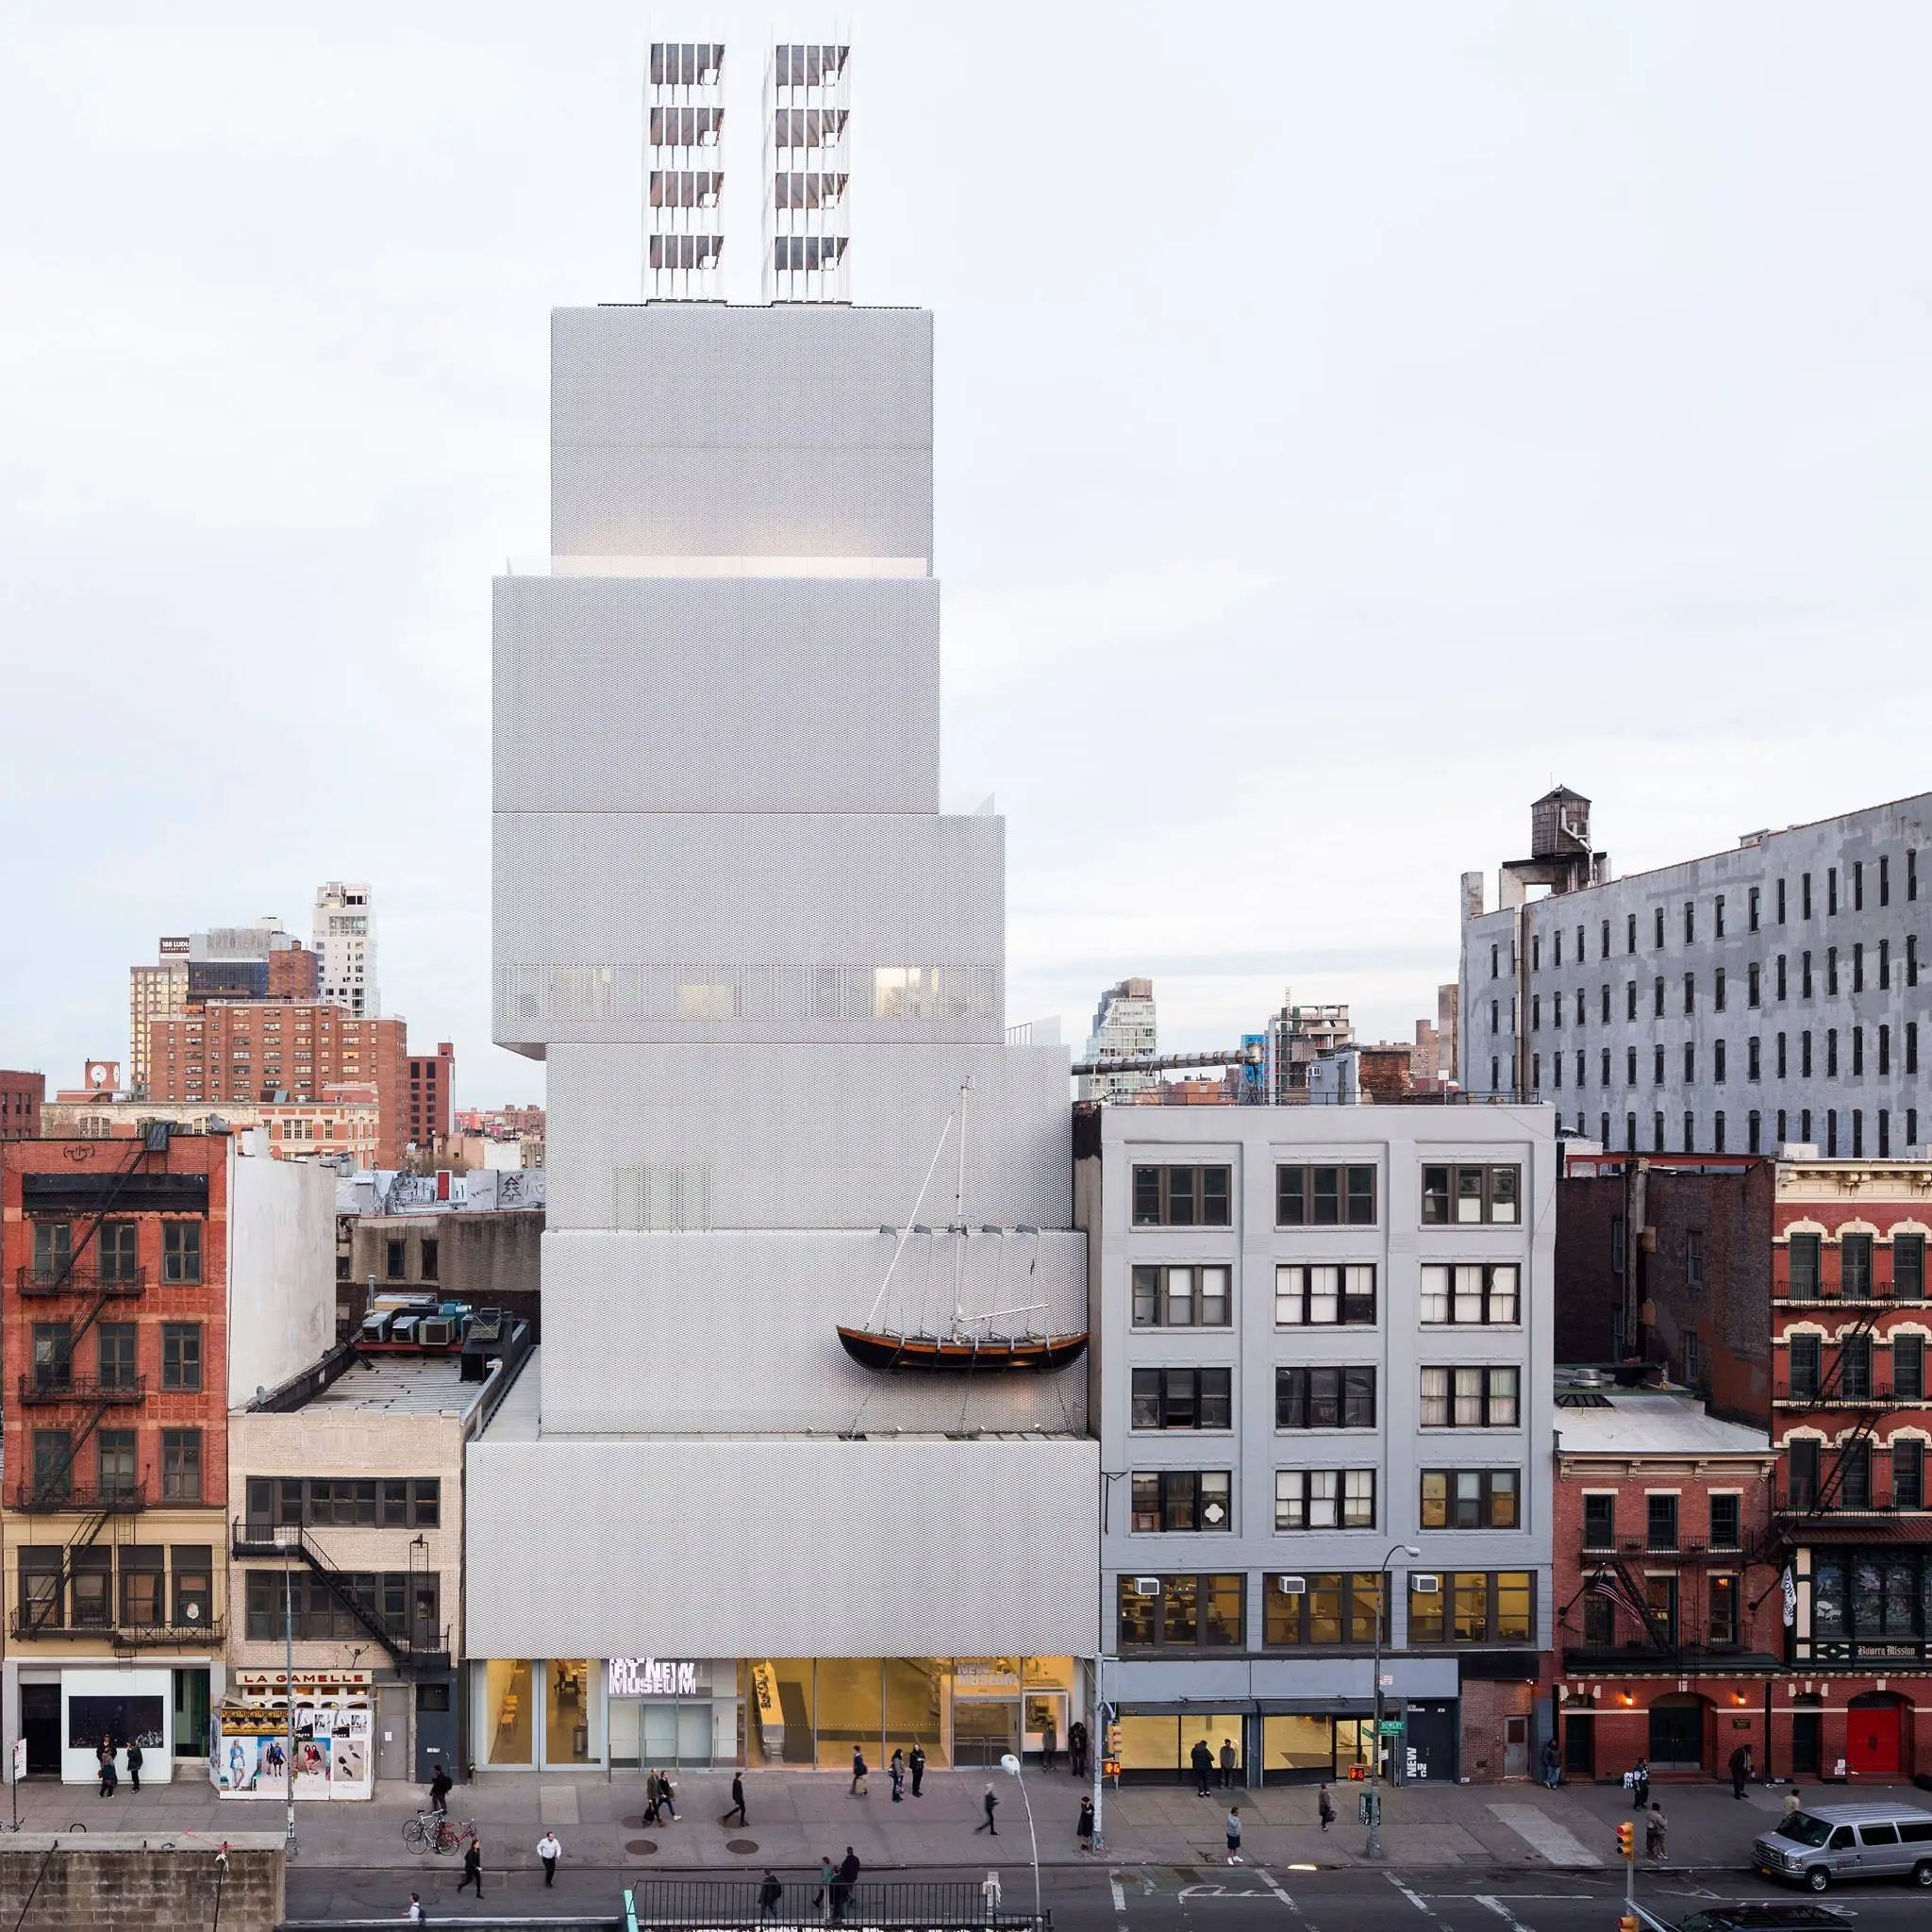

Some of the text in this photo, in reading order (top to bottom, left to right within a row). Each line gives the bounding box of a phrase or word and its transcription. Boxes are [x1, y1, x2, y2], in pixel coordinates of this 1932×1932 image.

[1887, 1645, 1916, 1656] Mission
[645, 1662, 695, 1678] NEW
[244, 1674, 364, 1683] LA GAMELLE
[608, 1678, 696, 1693] MUSEUM
[1407, 1747, 1417, 1777] NEW
